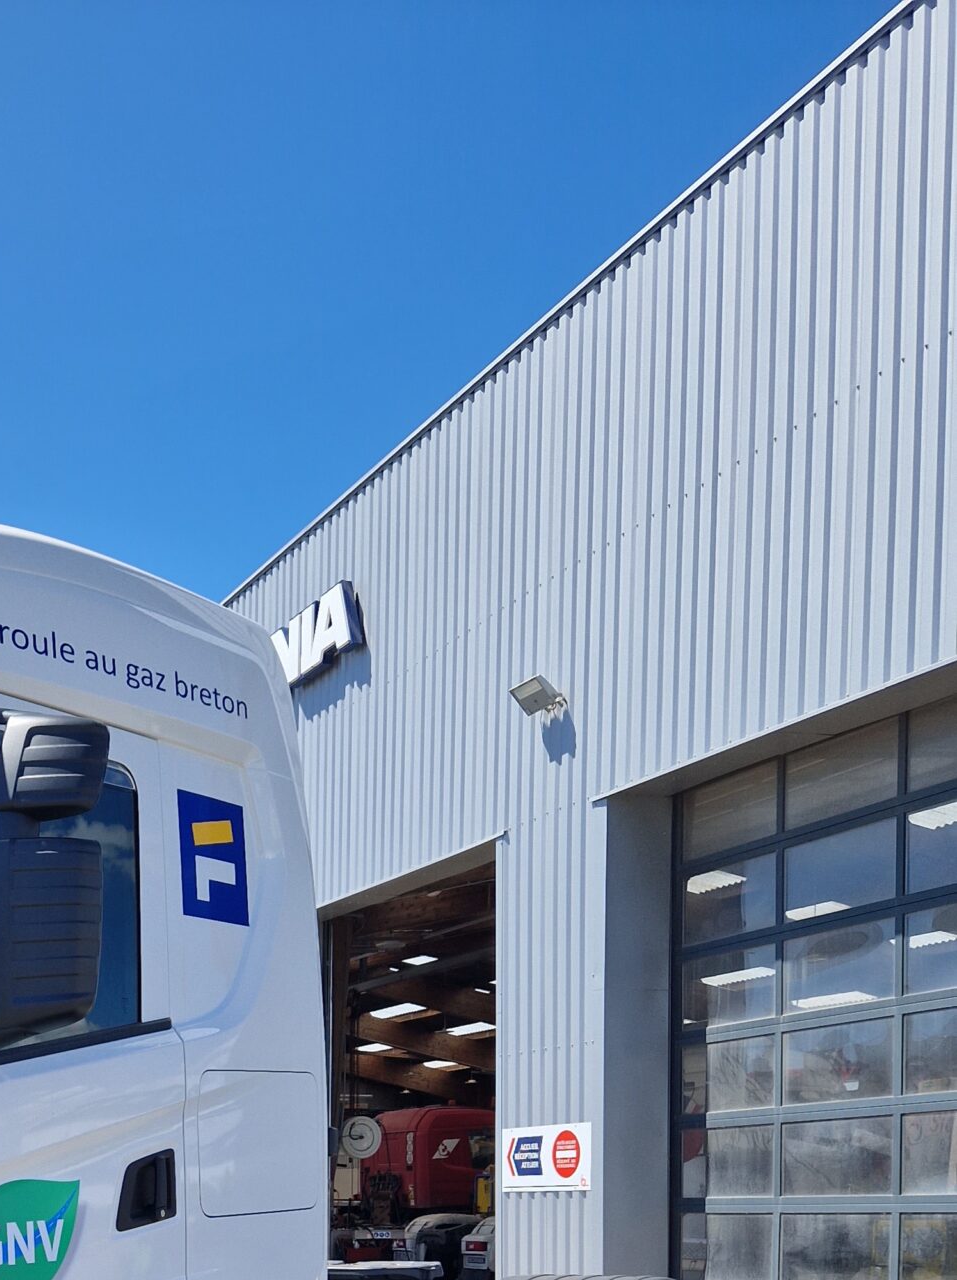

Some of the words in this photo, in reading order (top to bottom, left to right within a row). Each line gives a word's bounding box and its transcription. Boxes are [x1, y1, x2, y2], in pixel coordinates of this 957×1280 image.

[85, 650, 117, 677] au
[126, 662, 167, 692] gaz
[174, 671, 248, 719] breton
